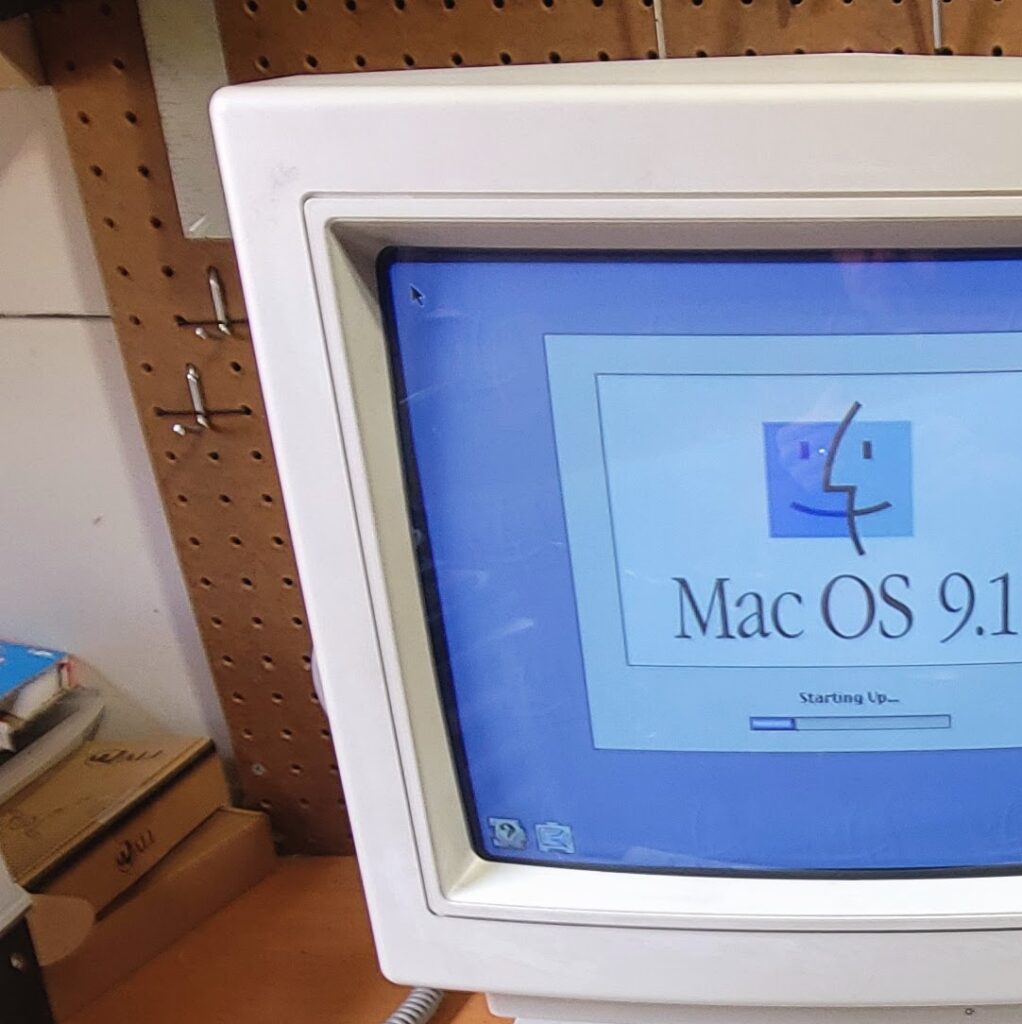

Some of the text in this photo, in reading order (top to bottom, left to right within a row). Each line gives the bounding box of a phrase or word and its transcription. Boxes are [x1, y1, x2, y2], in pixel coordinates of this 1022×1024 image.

[672, 571, 1018, 644] Mac OS 9.1
[799, 692, 864, 706] Starting
